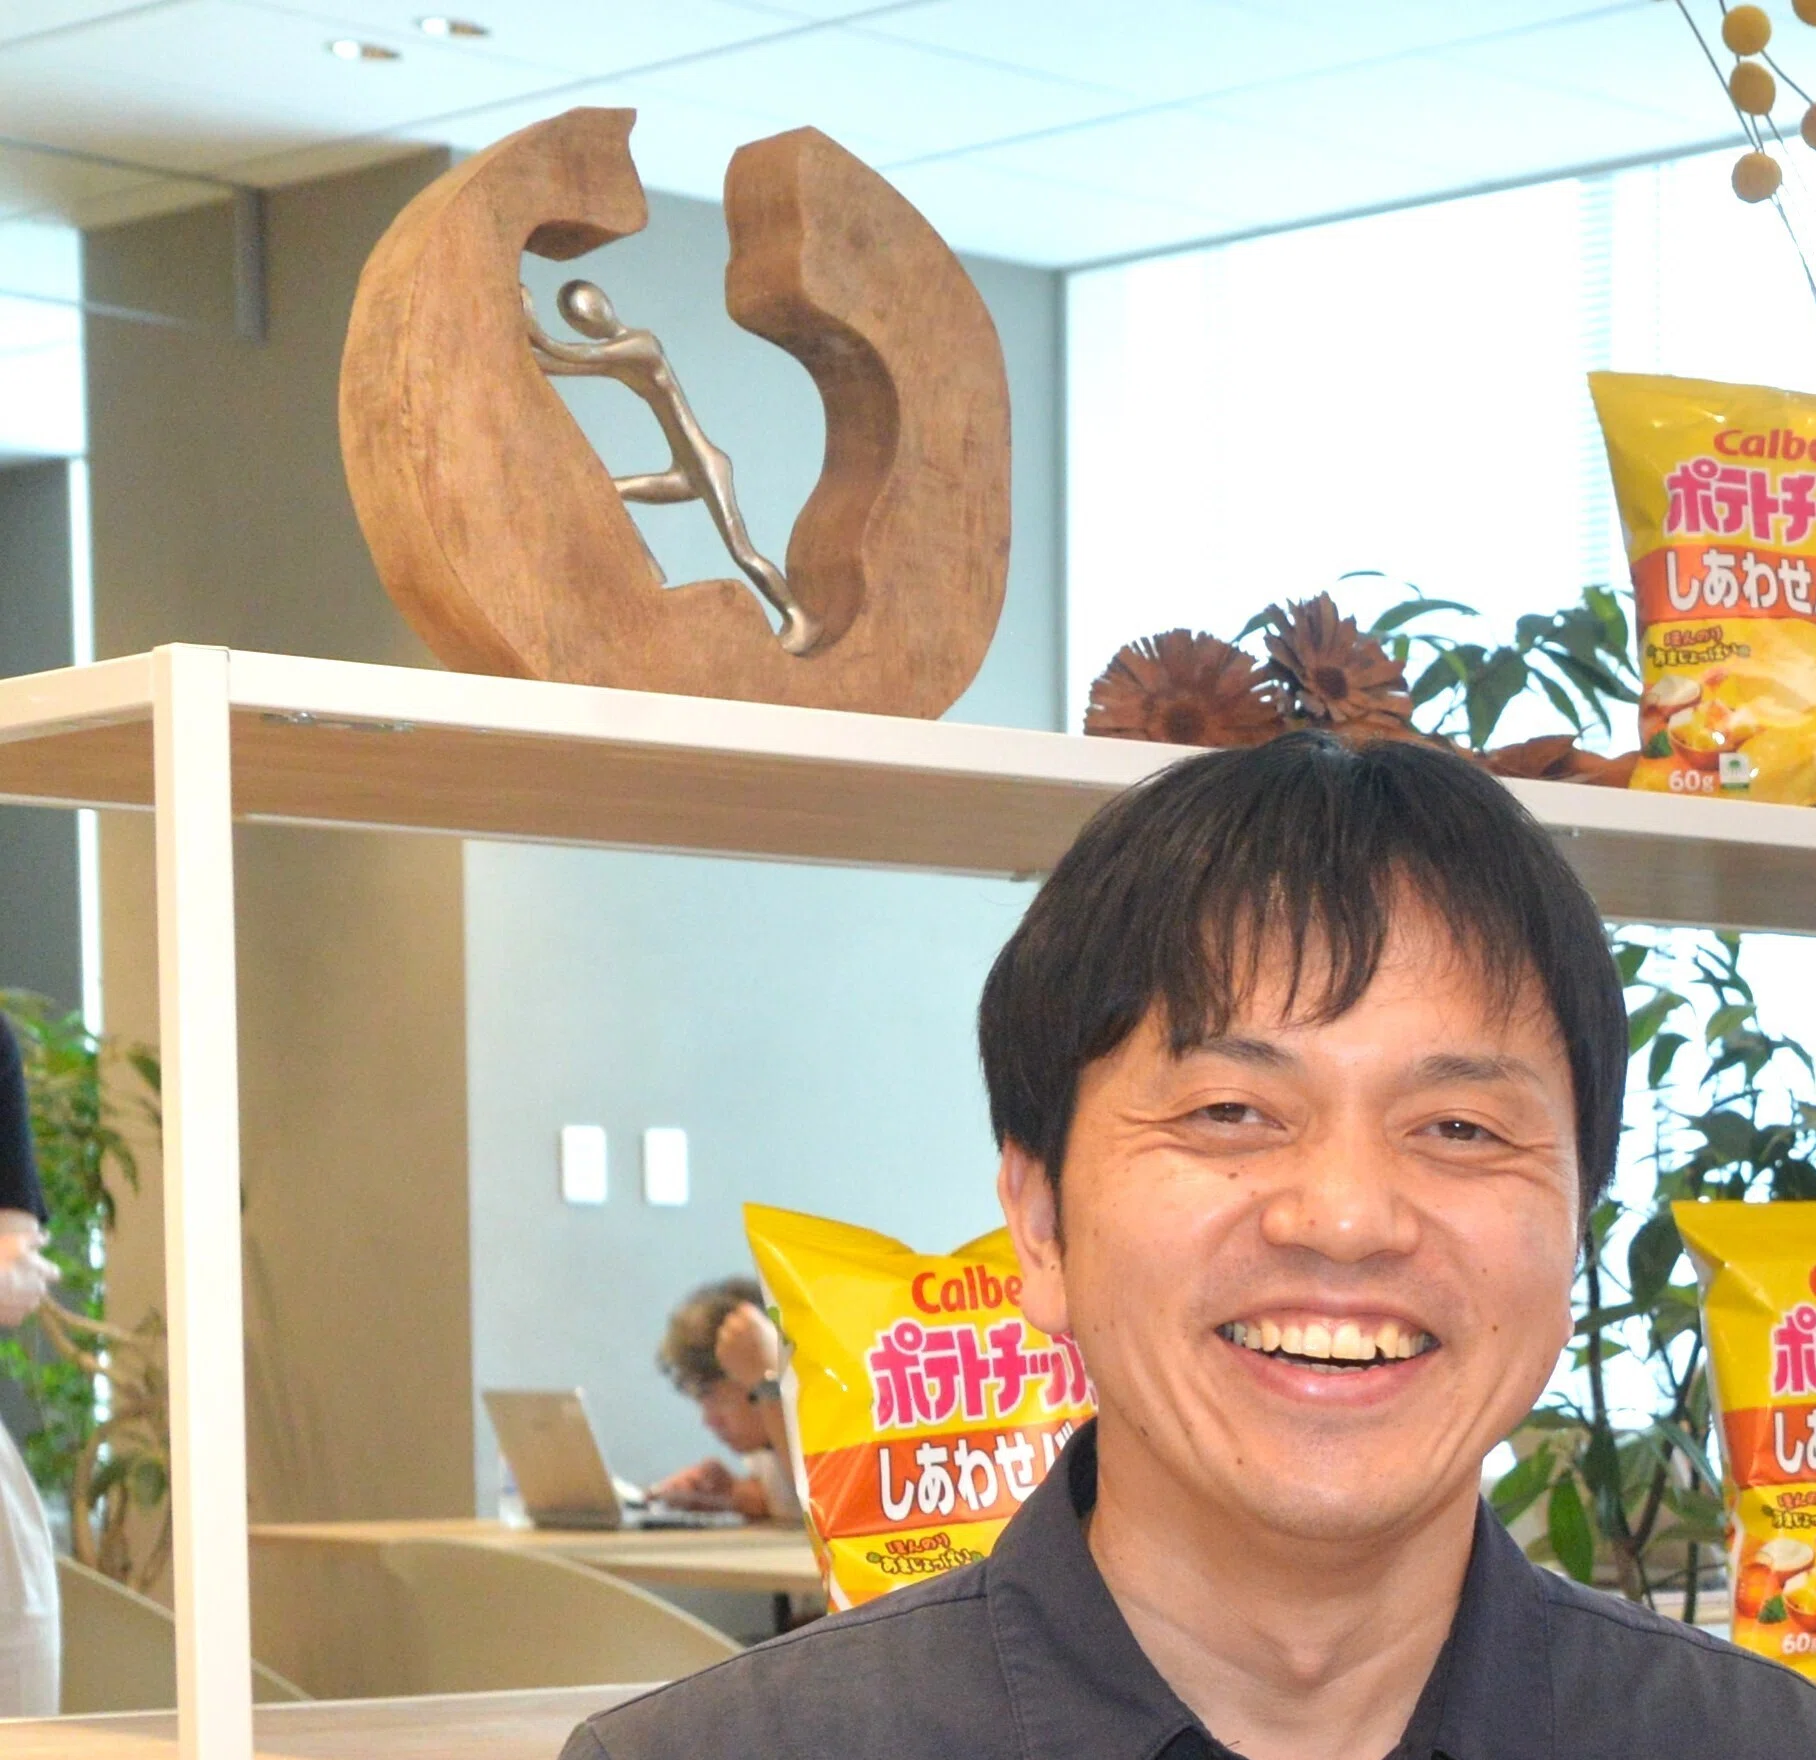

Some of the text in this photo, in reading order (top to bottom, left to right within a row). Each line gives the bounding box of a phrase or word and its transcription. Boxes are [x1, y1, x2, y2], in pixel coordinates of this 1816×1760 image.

[1667, 769, 1714, 793] 60g
[911, 1265, 1023, 1315] Calbe
[870, 1322, 1098, 1428] ポテトチップ
